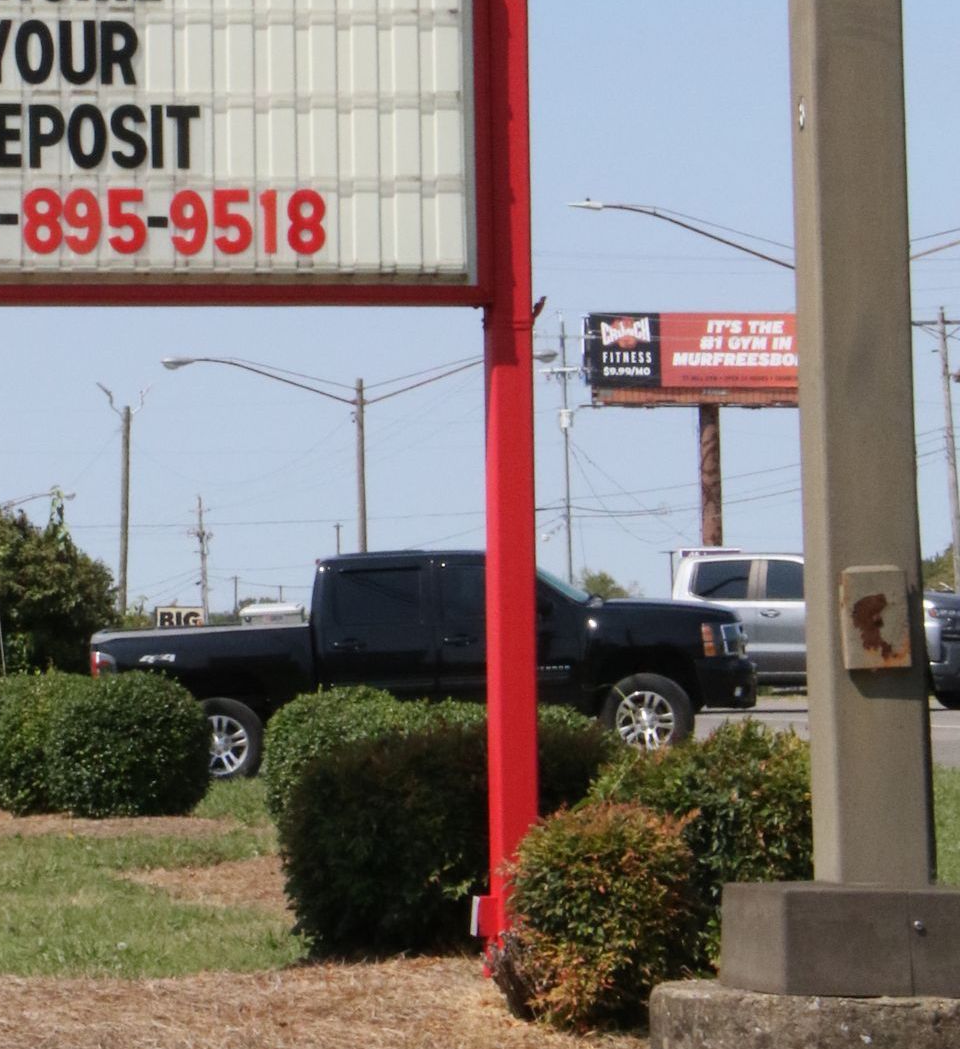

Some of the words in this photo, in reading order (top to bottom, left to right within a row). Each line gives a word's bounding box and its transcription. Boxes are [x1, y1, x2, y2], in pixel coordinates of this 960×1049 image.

[707, 320, 743, 334] IT'S
[748, 320, 785, 334] THE
[728, 336, 767, 350] GYM
[772, 336, 793, 350] IN
[602, 351, 652, 364] FITNESS
